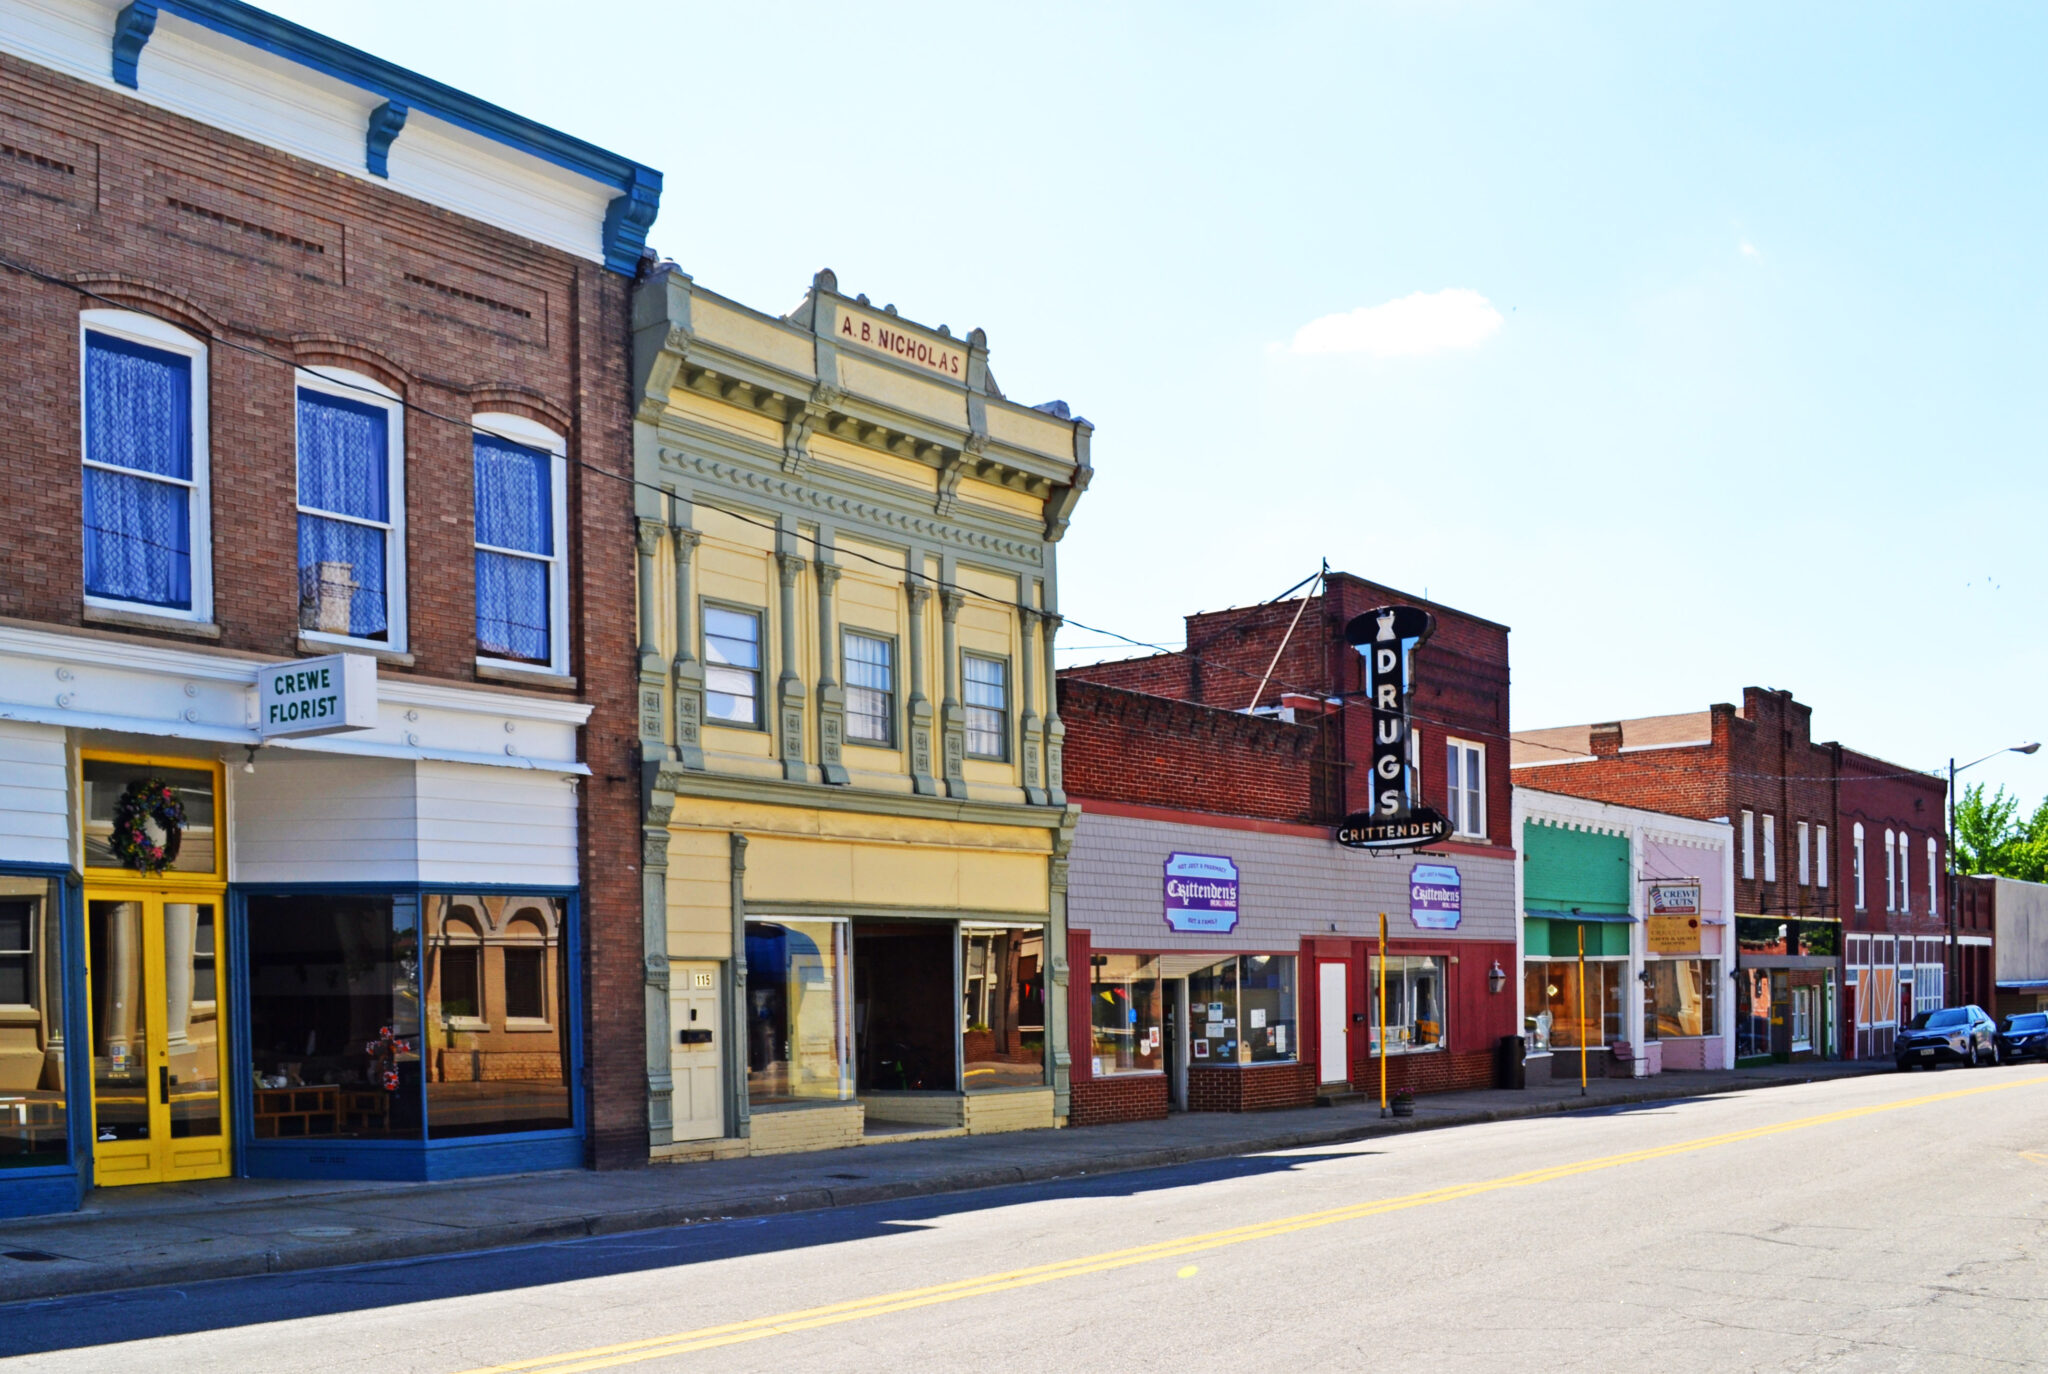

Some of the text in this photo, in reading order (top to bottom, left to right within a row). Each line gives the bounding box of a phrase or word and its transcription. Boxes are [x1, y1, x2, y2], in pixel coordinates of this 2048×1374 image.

[878, 328, 959, 374] NICHOLAS
[274, 668, 330, 695] CREWE
[269, 696, 337, 724] FLORIST
[1377, 648, 1401, 815] DRUGS
[1339, 821, 1443, 842] CRITTENDEN
[1663, 889, 1698, 898] CREWE
[697, 975, 710, 985] 115
